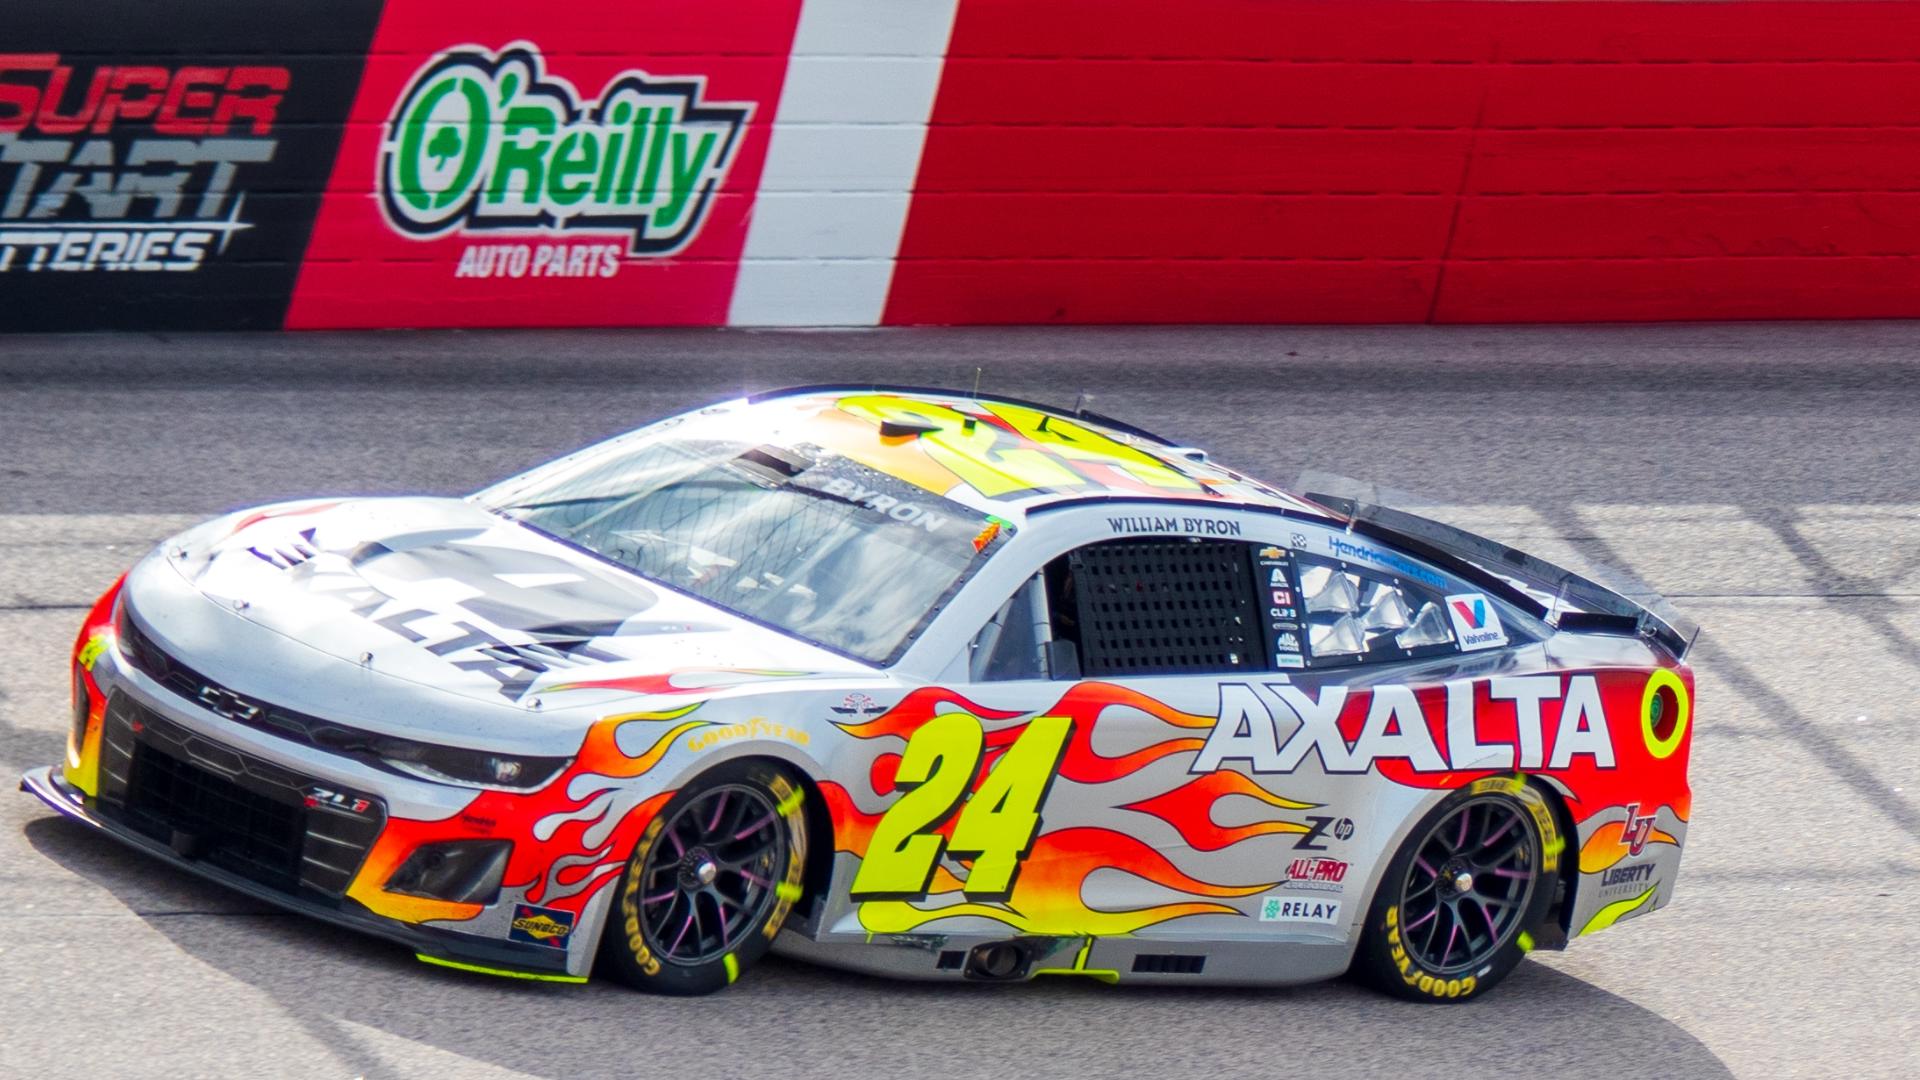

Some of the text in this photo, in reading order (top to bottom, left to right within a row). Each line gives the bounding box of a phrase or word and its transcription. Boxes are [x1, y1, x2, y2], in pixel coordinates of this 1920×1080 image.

[0, 53, 291, 134] SUPER
[392, 66, 722, 233] O'Reilly
[0, 132, 278, 218] TART
[456, 244, 621, 278] AUTO PARTS
[822, 477, 948, 533] BYRON
[1107, 516, 1242, 537] WILLIAM BYRON
[1463, 631, 1500, 645] Valvoline
[687, 716, 811, 753] GOODYEAR
[1187, 674, 1617, 776] AXALTA
[850, 711, 1077, 903] 24
[1287, 858, 1349, 884] ALL-PRO
[1601, 863, 1657, 887] LIBERTY
[513, 918, 570, 937] SUNOCO
[1281, 901, 1338, 920] RELAY
